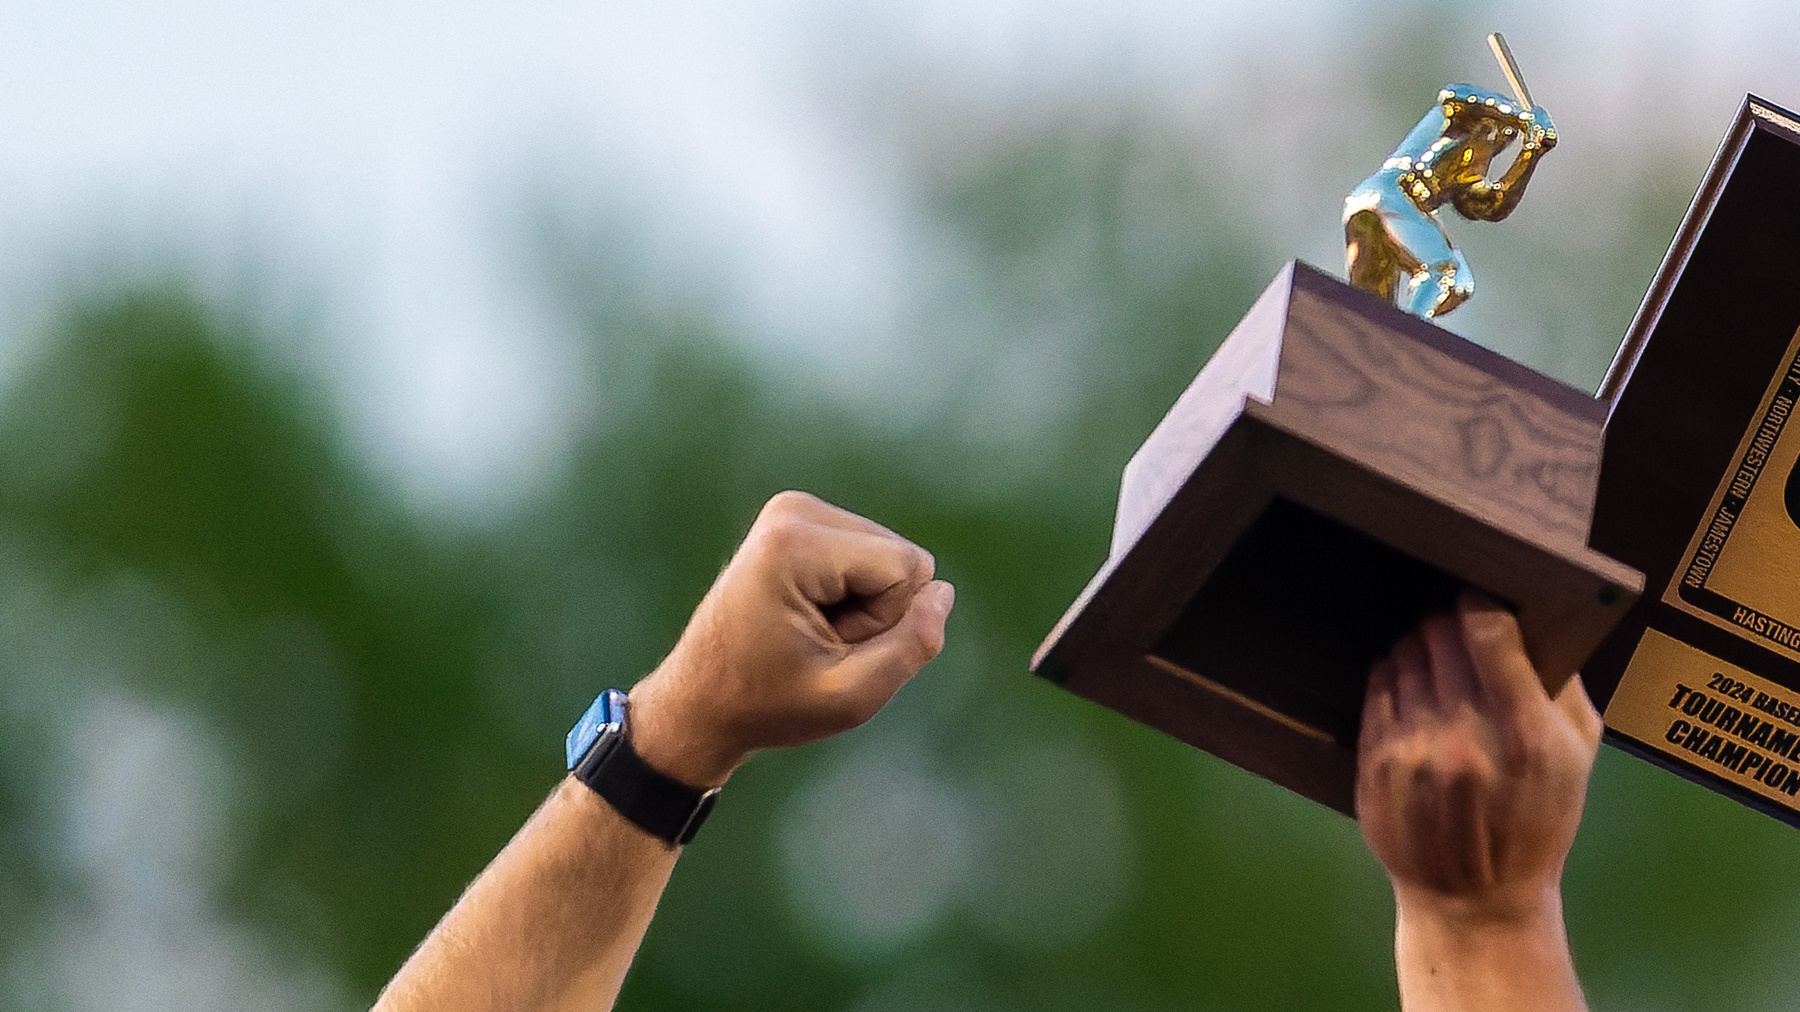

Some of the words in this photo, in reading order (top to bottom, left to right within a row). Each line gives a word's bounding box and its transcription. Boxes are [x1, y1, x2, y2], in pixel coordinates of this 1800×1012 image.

[1729, 395, 1793, 500] NORTHWESTERN
[1685, 505, 1736, 589] JAMESTOWN
[1706, 672, 1756, 704] 2024
